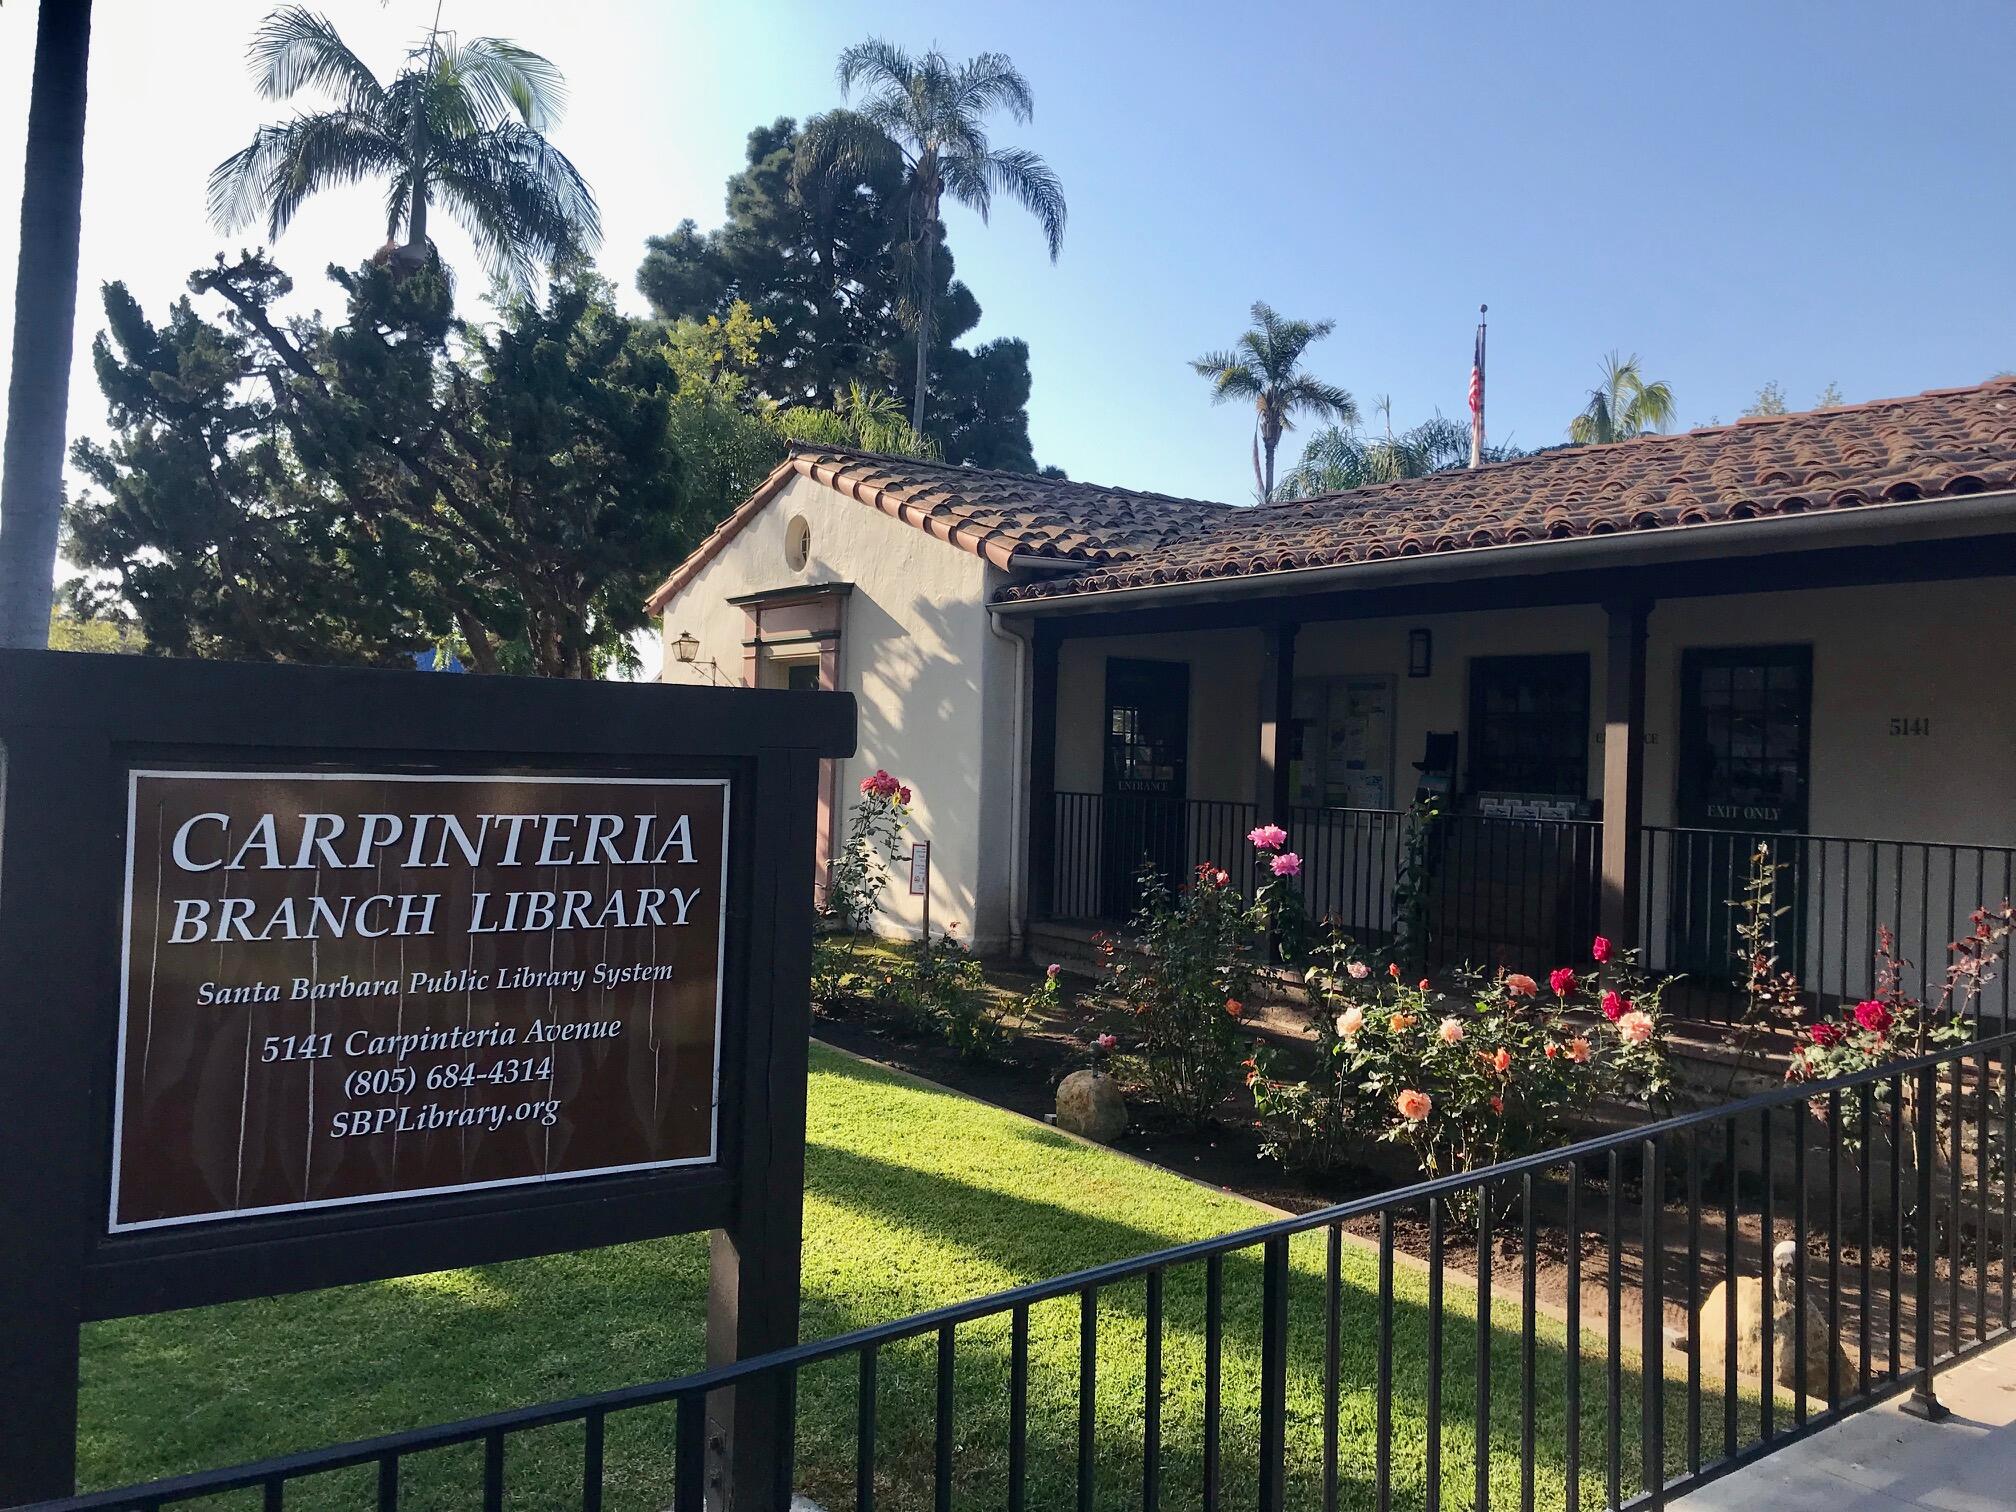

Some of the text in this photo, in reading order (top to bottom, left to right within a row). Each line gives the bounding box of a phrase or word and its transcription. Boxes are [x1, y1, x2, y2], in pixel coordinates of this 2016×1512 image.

[1889, 717, 1930, 736] 5141
[1118, 780, 1169, 792] ENTRANCE
[1706, 804, 1782, 821] EXIT ONLY
[171, 811, 699, 872] CARPINTERIA
[167, 887, 701, 944] BRANCH LIBRARY
[197, 961, 673, 1006] Santa Barbara Public Library System
[261, 1016, 622, 1068] 5141 Carpinteria Avenue
[344, 1056, 552, 1099] (805) 684-4314
[329, 1096, 561, 1139] SBPLibrary.org
